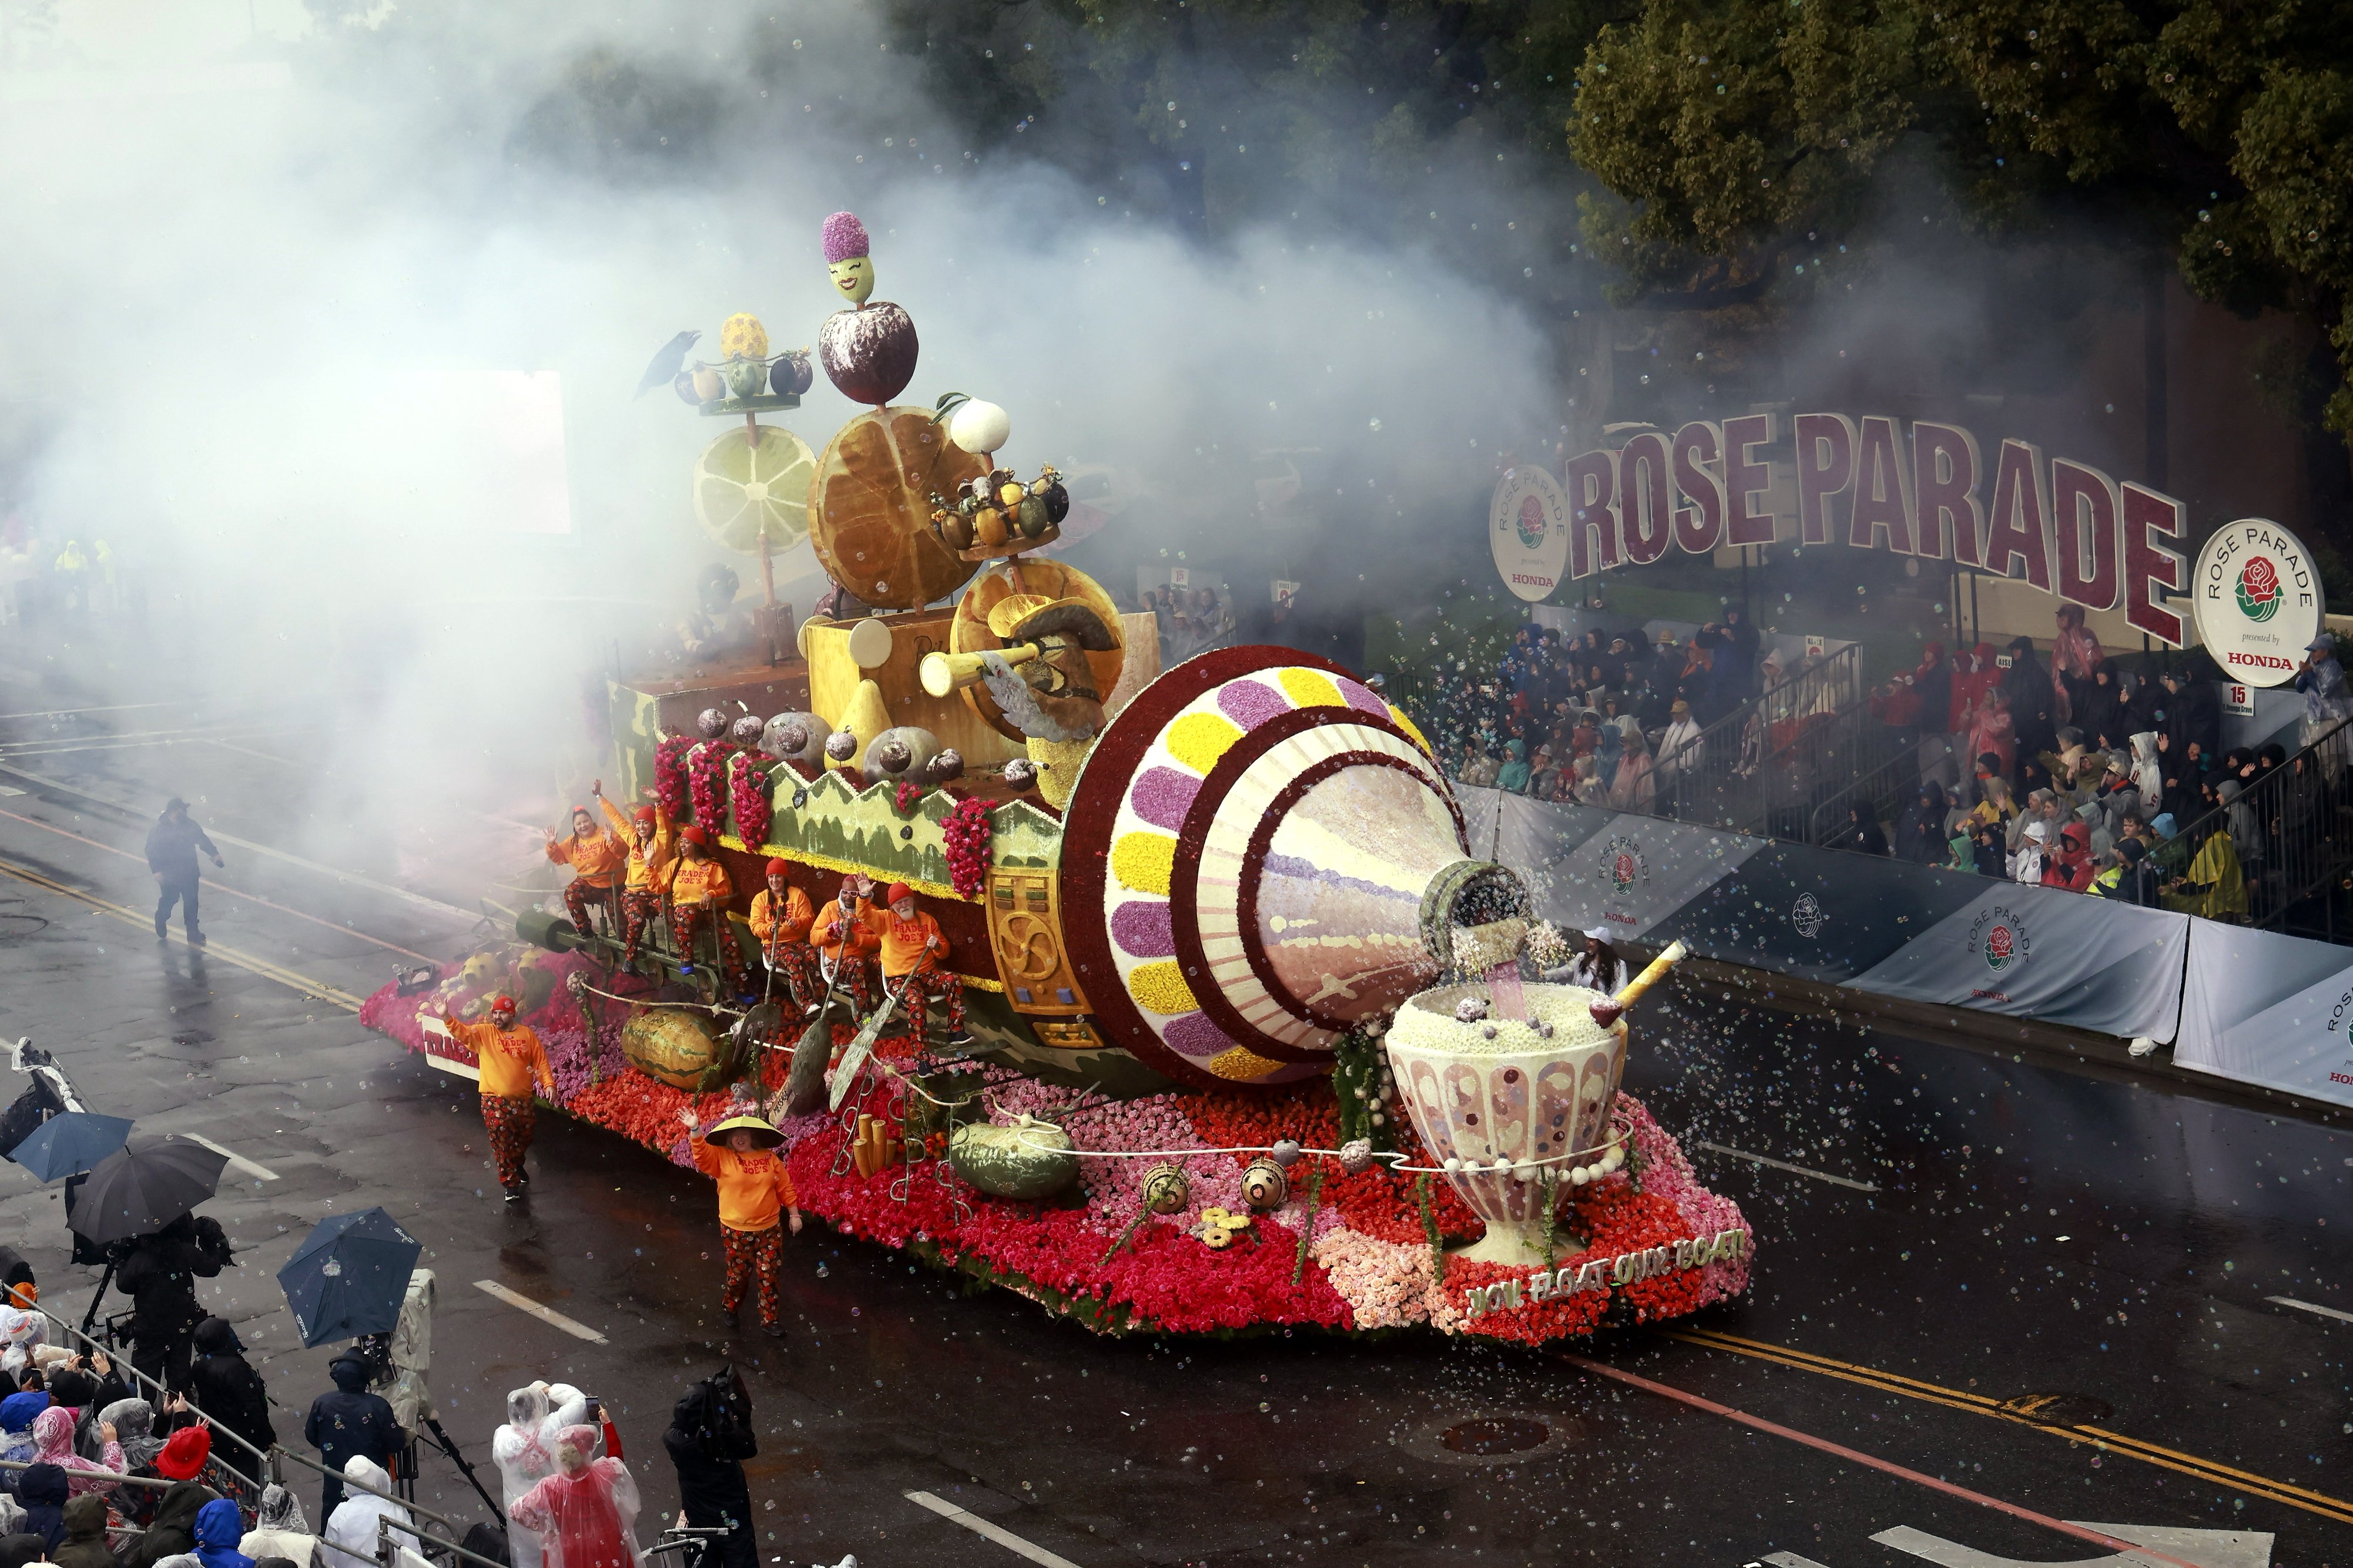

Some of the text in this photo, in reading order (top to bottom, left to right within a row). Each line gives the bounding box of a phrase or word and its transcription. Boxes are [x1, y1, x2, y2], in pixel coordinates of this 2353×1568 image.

[1500, 472, 1565, 536] ROSE PARADE
[1566, 413, 2191, 650] ROSE PARADE
[2209, 528, 2312, 607] ROSE PARADE
[1512, 573, 1554, 587] HONDA
[2242, 633, 2280, 645] presented by
[1998, 658, 2011, 667] AISL
[2228, 652, 2294, 671] HONDA
[2231, 686, 2246, 704] 15
[1598, 840, 1617, 879] ROSE
[1604, 912, 1637, 925] HONDA
[898, 933, 924, 942] JOE'S
[1968, 906, 2030, 963] ROSE PARADE
[2328, 987, 2353, 1031] ROS
[743, 1165, 768, 1175] JOE'S
[1465, 1278, 1525, 1319] YOU
[1528, 1258, 1612, 1304] FLOAT
[1614, 1245, 1671, 1285] OUR
